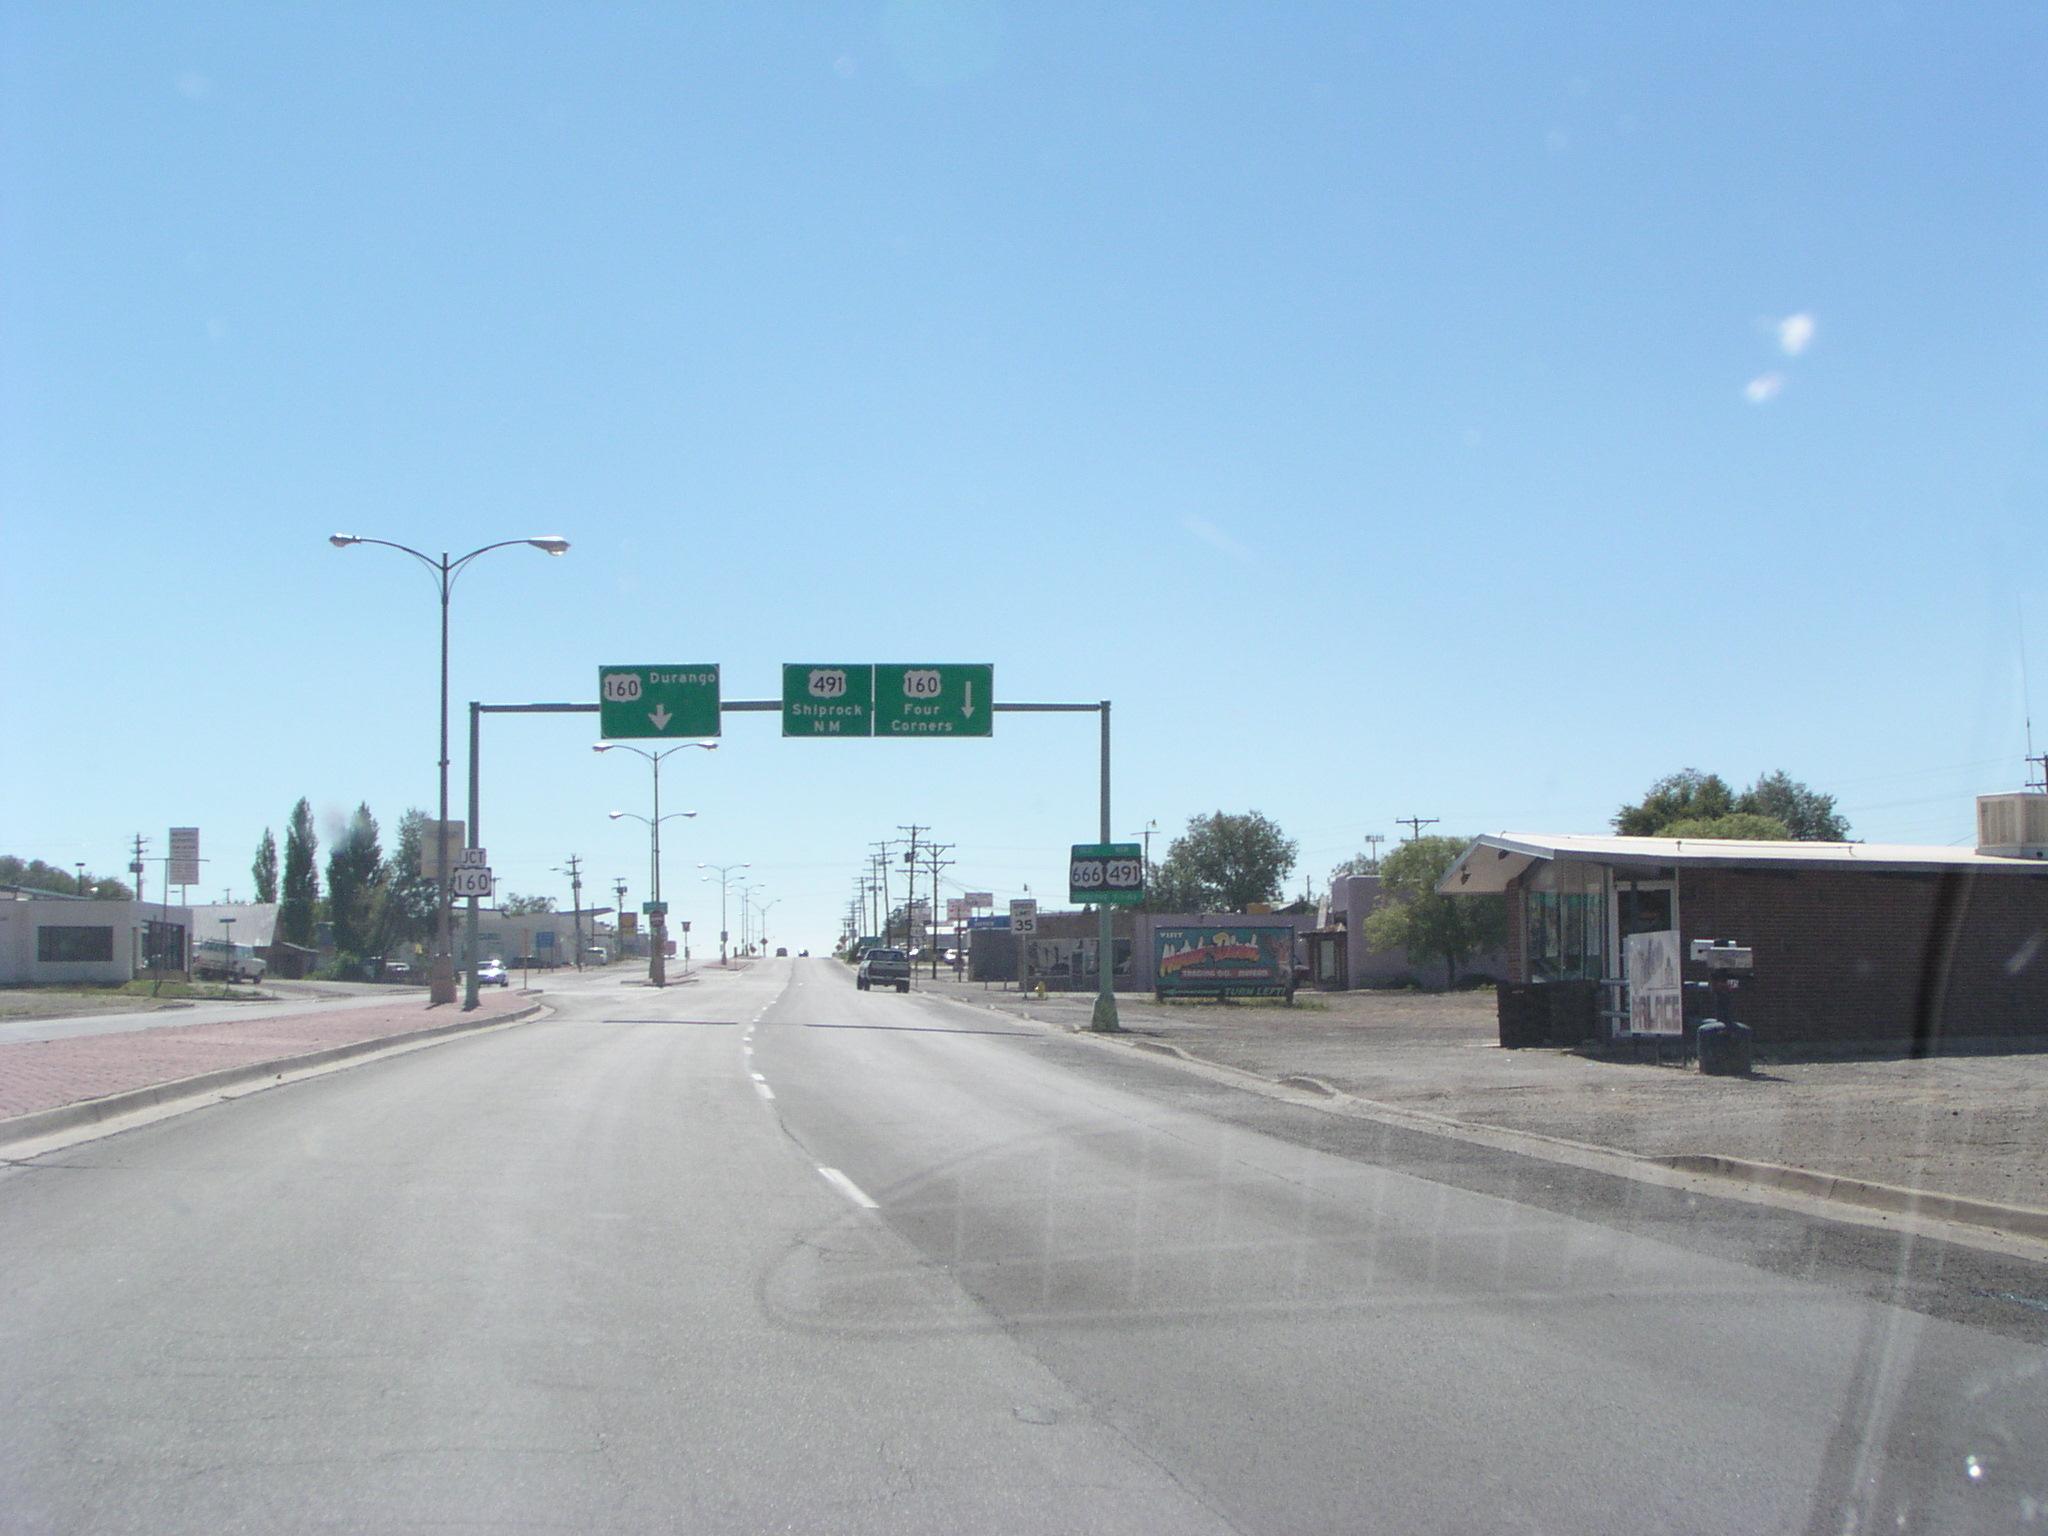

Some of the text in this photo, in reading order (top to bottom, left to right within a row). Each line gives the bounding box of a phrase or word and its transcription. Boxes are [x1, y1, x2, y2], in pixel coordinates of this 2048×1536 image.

[606, 672, 716, 697] 160 Durango
[813, 676, 843, 693] 491
[906, 677, 938, 693] 160
[792, 703, 862, 716] Shiprock
[904, 703, 940, 715] Four
[891, 719, 952, 732] Corners
[463, 851, 483, 864] JCT
[1072, 866, 1100, 882] 666
[1109, 865, 1138, 882] 491
[458, 874, 488, 890] 160
[1015, 919, 1033, 931] 35
